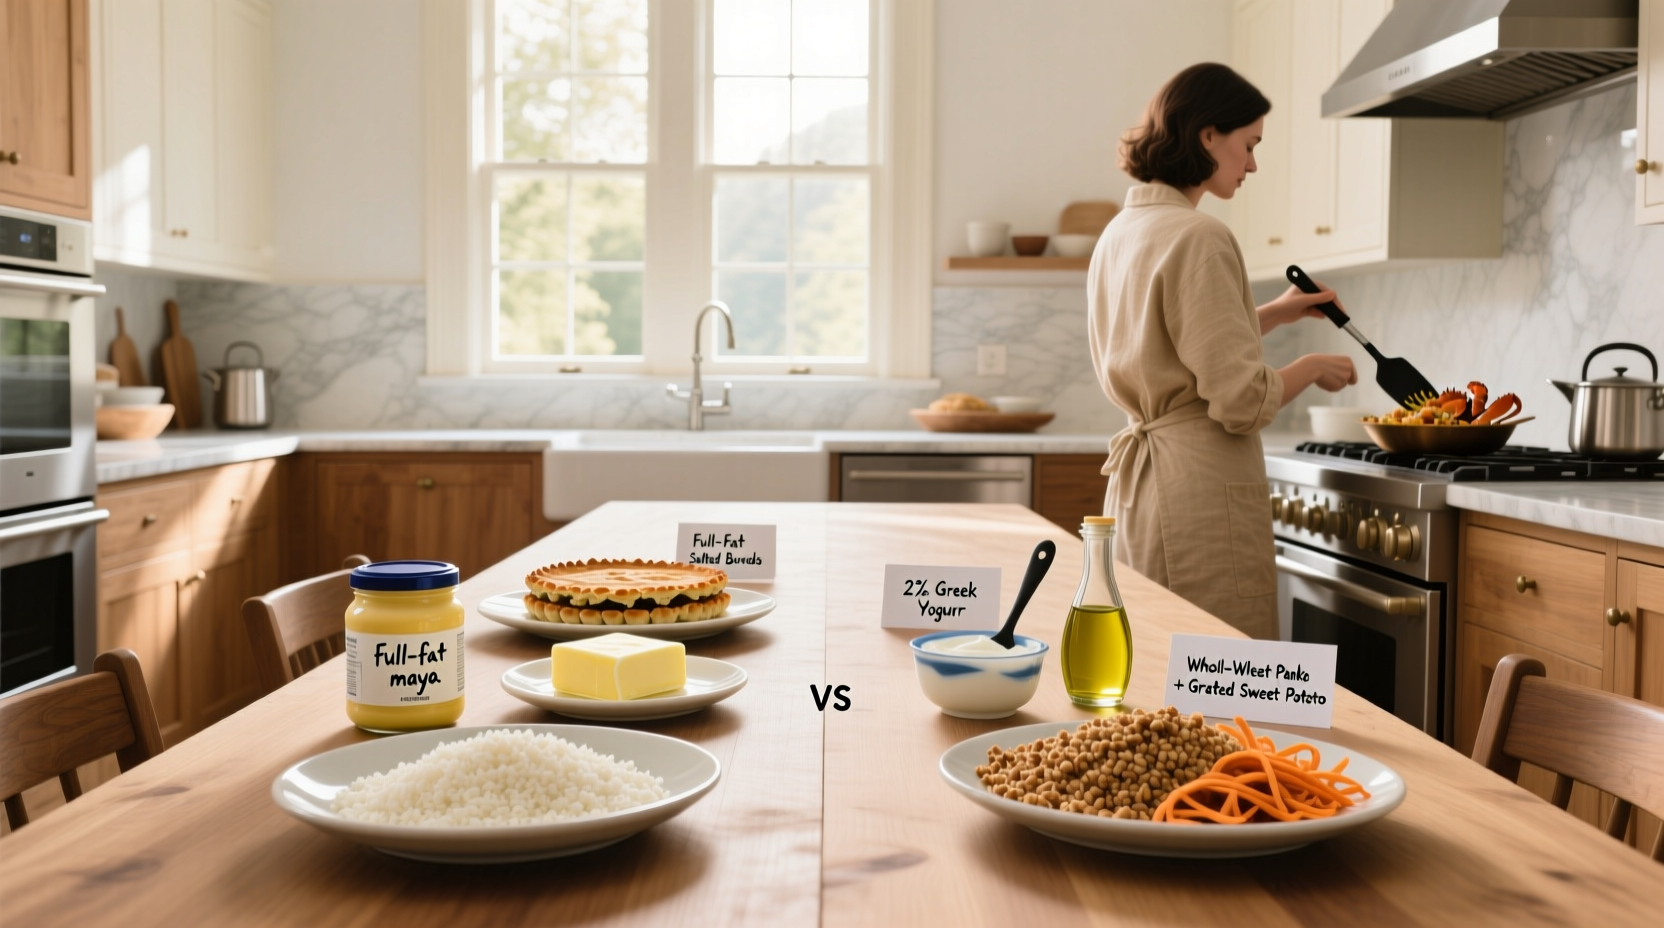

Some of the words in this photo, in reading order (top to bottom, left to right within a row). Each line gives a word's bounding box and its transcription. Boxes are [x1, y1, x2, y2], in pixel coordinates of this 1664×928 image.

[693, 533, 745, 548] Full-Fat
[903, 579, 929, 597] 2%
[935, 580, 977, 598] Greek
[374, 641, 447, 667] Full-fat
[391, 671, 441, 696] maya
[1276, 664, 1310, 682] Panko
[1173, 679, 1184, 690] +
[1188, 678, 1235, 697] Grated
[1240, 683, 1280, 701] Sweet
